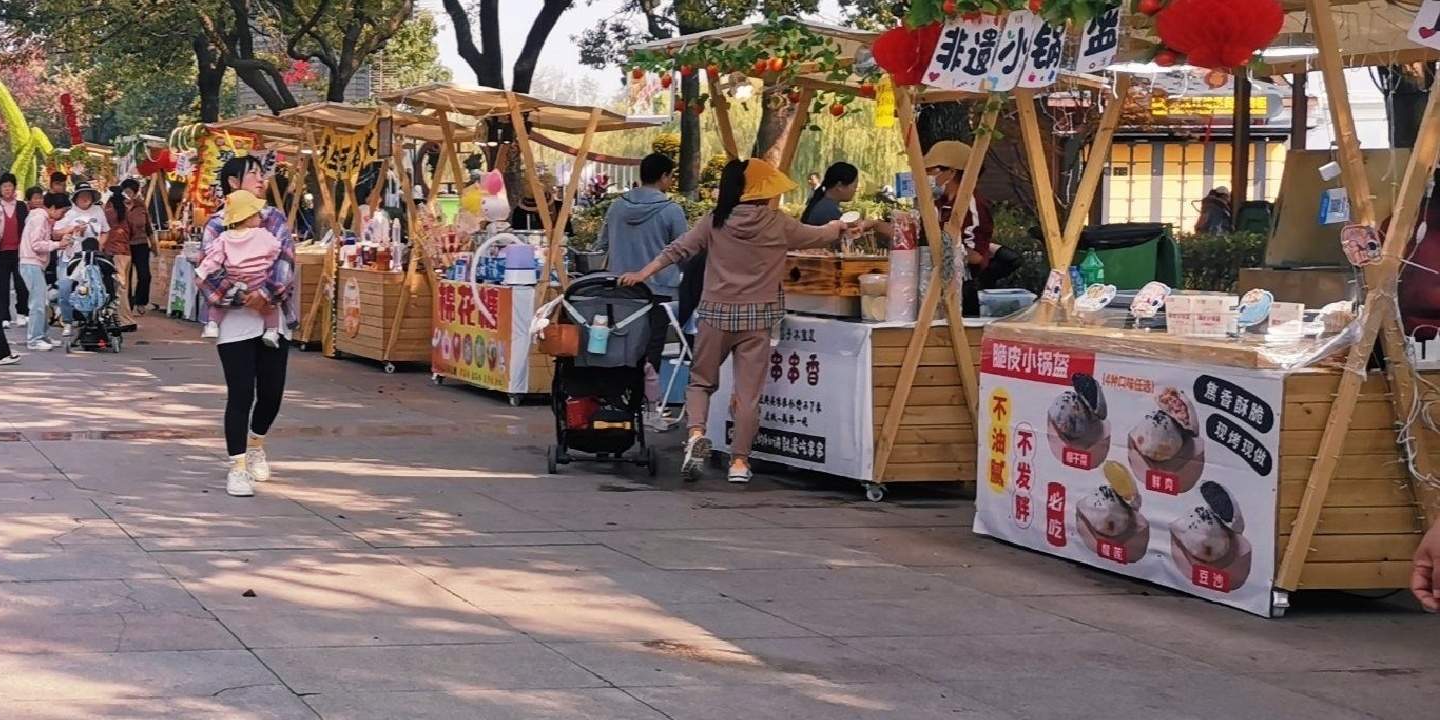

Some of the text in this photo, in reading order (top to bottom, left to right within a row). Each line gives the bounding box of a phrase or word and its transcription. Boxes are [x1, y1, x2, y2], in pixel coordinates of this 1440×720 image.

[992, 342, 1070, 379] 脆皮小锅盔
[1203, 380, 1265, 425] 焦香酥脆
[990, 395, 1008, 488] 不油腻
[1213, 420, 1268, 468] 现烤现做
[1015, 430, 1033, 523] 不发胖
[1048, 491, 1064, 539] 必吃
[1198, 568, 1225, 590] 豆沙
